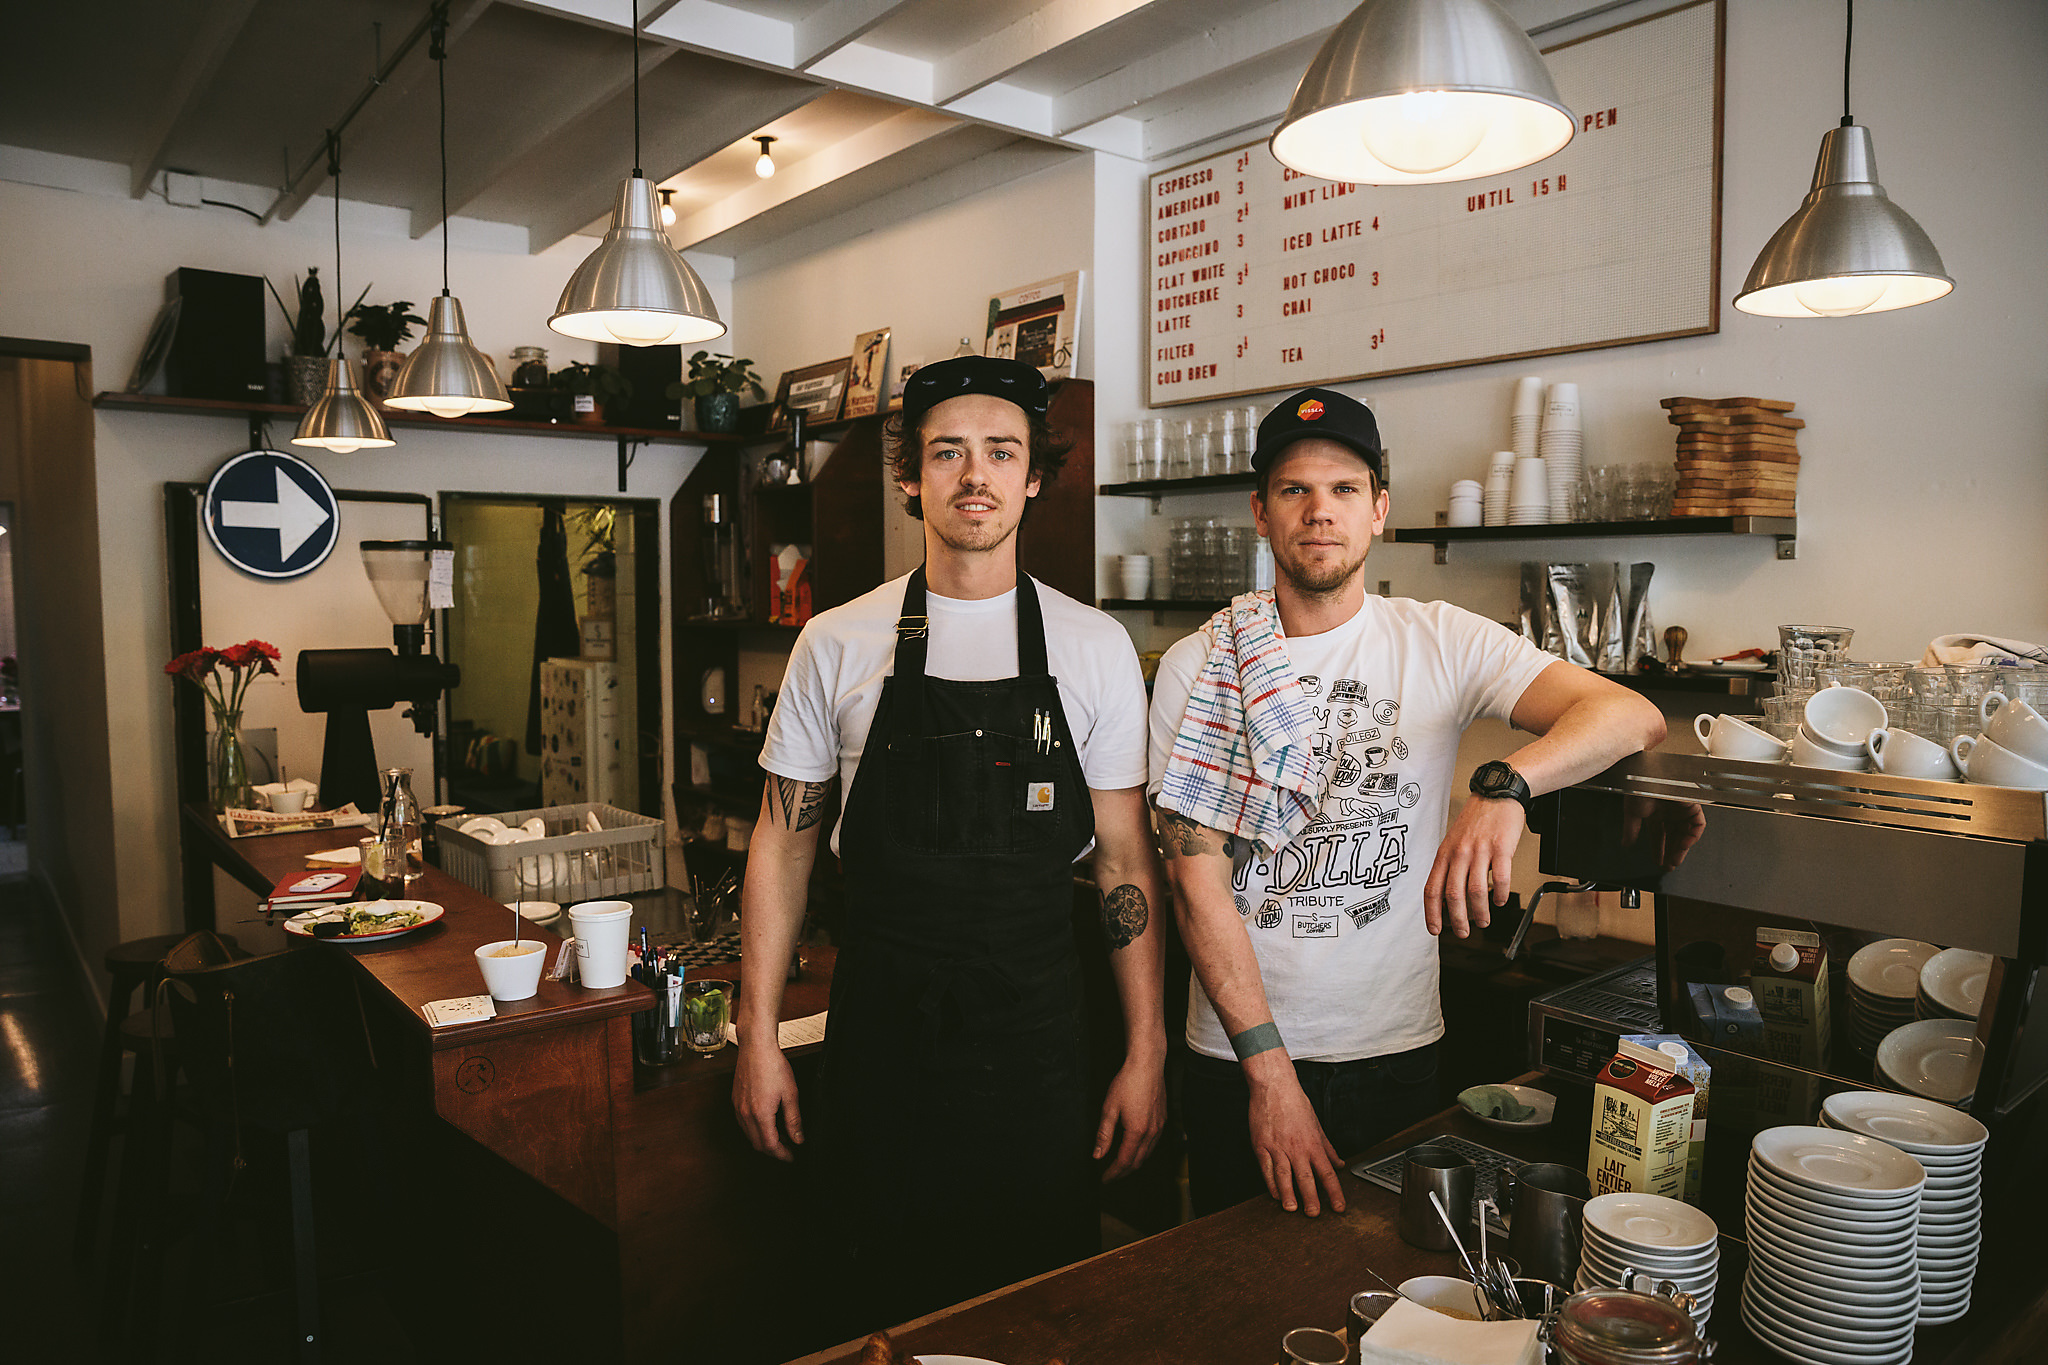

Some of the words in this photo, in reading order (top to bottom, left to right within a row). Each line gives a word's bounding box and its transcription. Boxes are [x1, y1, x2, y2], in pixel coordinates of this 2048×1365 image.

[1583, 107, 1617, 132] PEN
[1158, 168, 1213, 197] ESPRESSO
[1467, 187, 1514, 213] UNTIL
[1533, 178, 1549, 198] 15
[1558, 174, 1567, 192] H
[1157, 190, 1220, 221] AMERICANO
[1237, 180, 1244, 195] 3
[1284, 189, 1316, 211] MINT
[1158, 219, 1206, 244] CORTADO
[1283, 231, 1313, 252] ICED
[1322, 220, 1362, 243] LATTE
[1372, 216, 1379, 231] 4
[1158, 239, 1220, 267] CAPUCCINO
[1237, 233, 1244, 248] 3
[1157, 272, 1185, 291] FLAT
[1192, 263, 1225, 283] WHITE
[1283, 272, 1307, 291] HOT
[1314, 262, 1356, 285] CHOCO
[1372, 271, 1380, 286] 3
[1157, 286, 1220, 312] BUTCHERKE
[1283, 298, 1311, 317] CHAI
[1157, 314, 1191, 334] LATTE
[1237, 304, 1244, 318] 3
[1157, 343, 1195, 362] FILTER
[1282, 347, 1303, 363] TEA
[1157, 369, 1183, 386] COLD
[1188, 363, 1218, 381] BREW
[1286, 895, 1345, 908] TRIBUTE
[1297, 921, 1332, 930] BUTCHERS
[1644, 1078, 1662, 1089] MELK
[1604, 1156, 1627, 1178] LAIT
[1596, 1167, 1632, 1194] ENTIER
